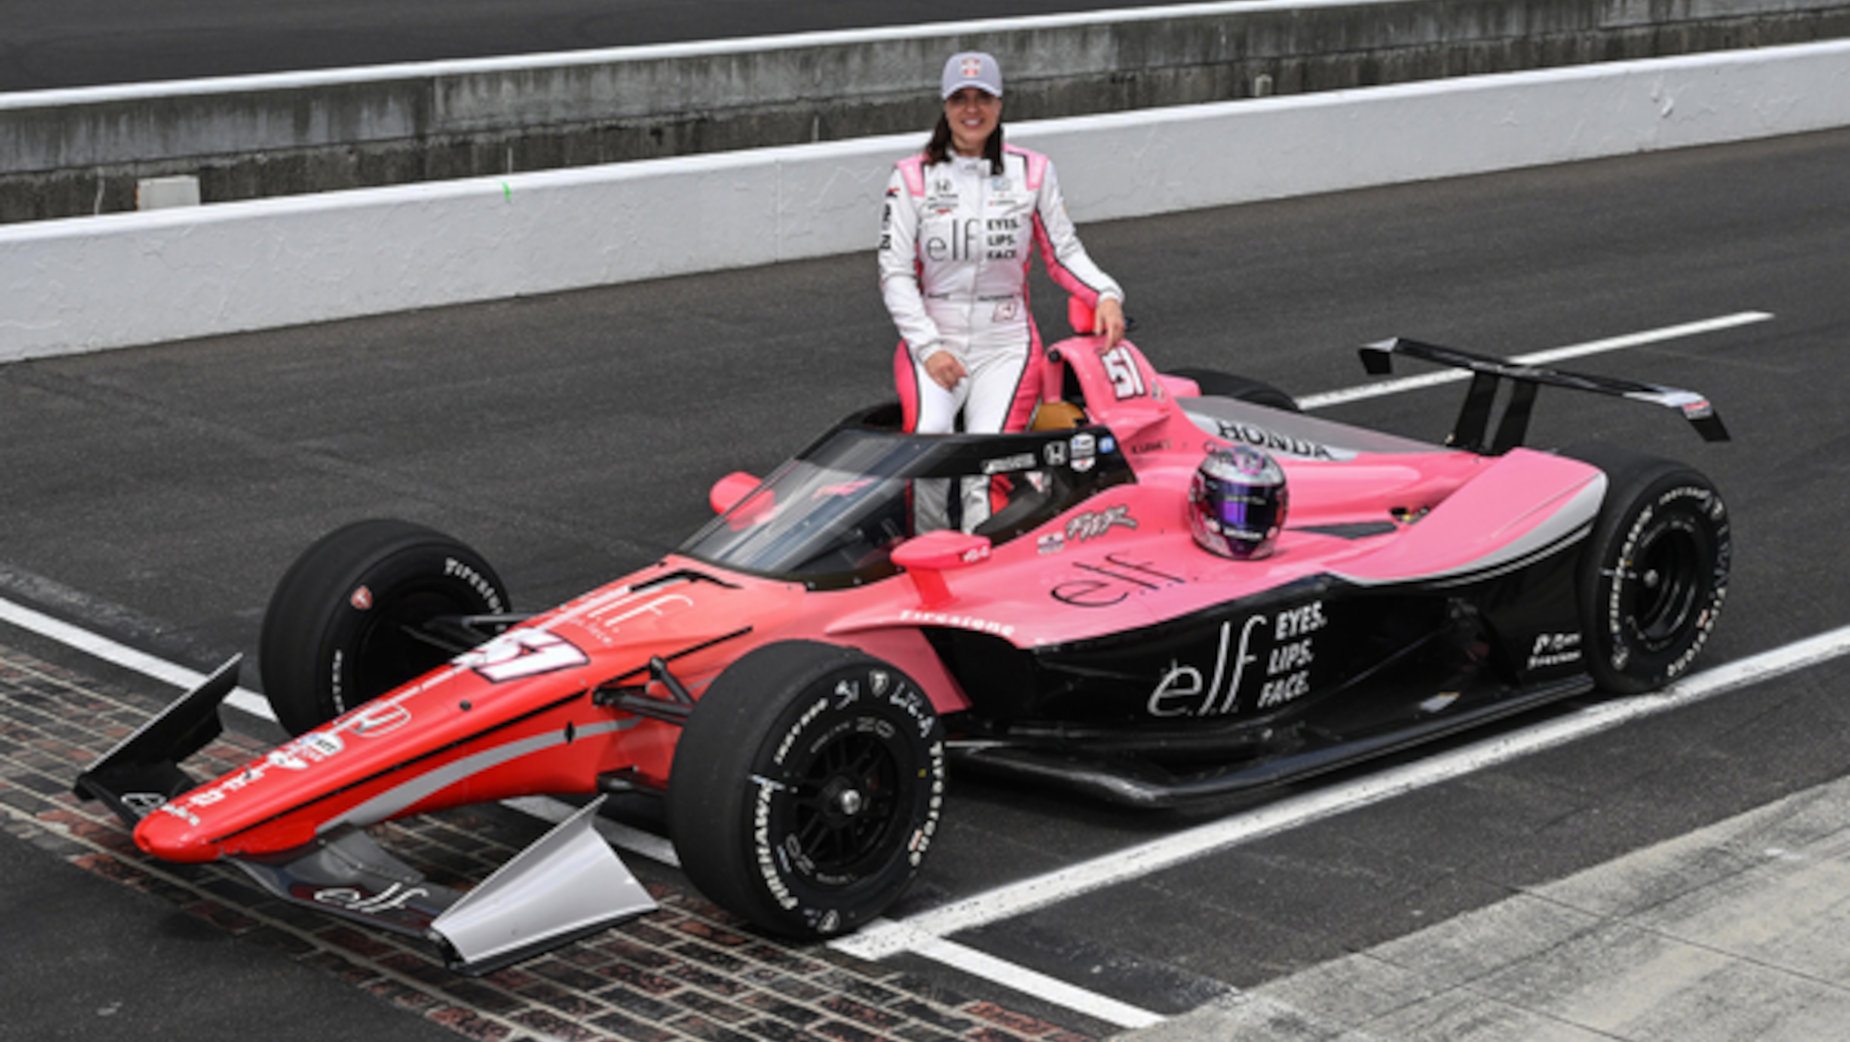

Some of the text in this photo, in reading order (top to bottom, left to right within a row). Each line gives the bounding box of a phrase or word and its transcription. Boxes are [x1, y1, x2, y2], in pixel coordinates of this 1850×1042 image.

[1217, 420, 1334, 461] HONDA
[899, 609, 1015, 637] Firestone
[1275, 600, 1327, 640] EYES.
[1267, 639, 1313, 676] LIPS.
[1257, 671, 1310, 708] FACE.
